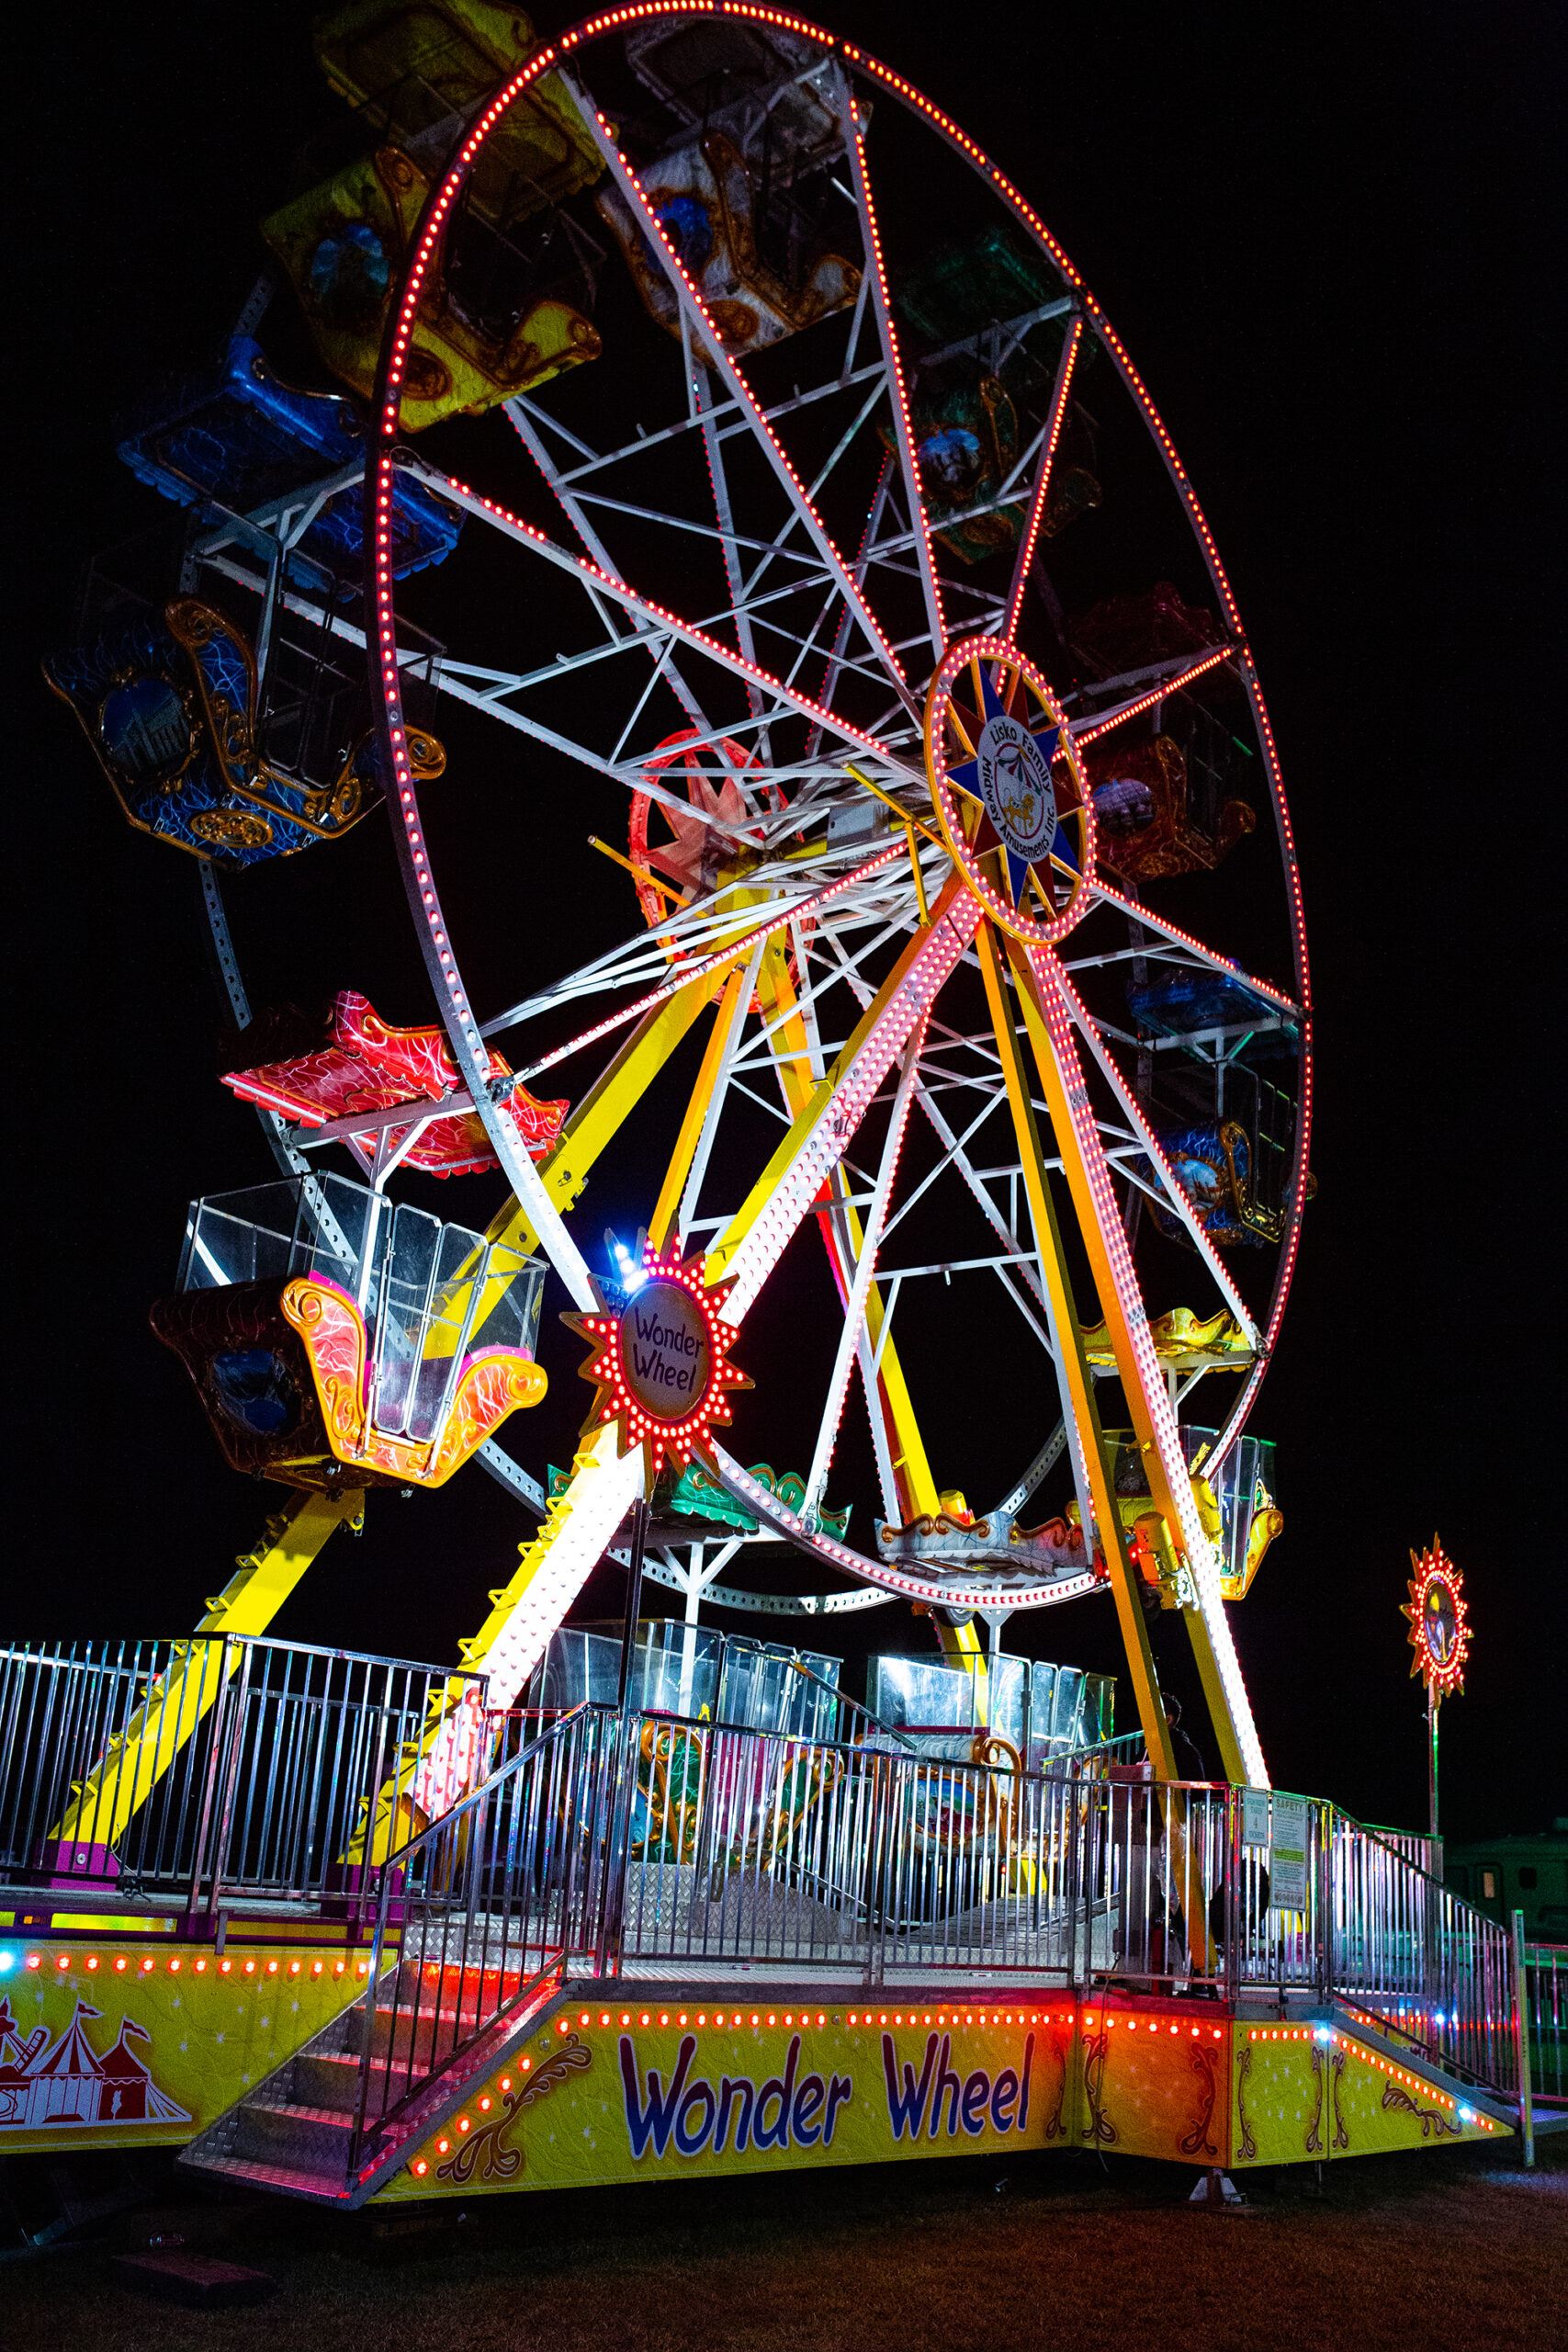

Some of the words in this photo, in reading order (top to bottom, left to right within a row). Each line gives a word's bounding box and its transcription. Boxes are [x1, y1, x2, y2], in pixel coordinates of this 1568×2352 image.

[989, 721, 1018, 745] Lisko
[1021, 731, 1052, 794] Family
[982, 754, 1002, 822] Midway
[999, 826, 1050, 859] Amusements
[1044, 806, 1055, 834] Inc.
[634, 1305, 705, 1359] Wonder
[633, 1343, 697, 1393] Wheel
[1276, 1798, 1303, 1812] SAFETY
[618, 2032, 852, 2160] Wonder
[881, 2030, 1035, 2142] Wheel
